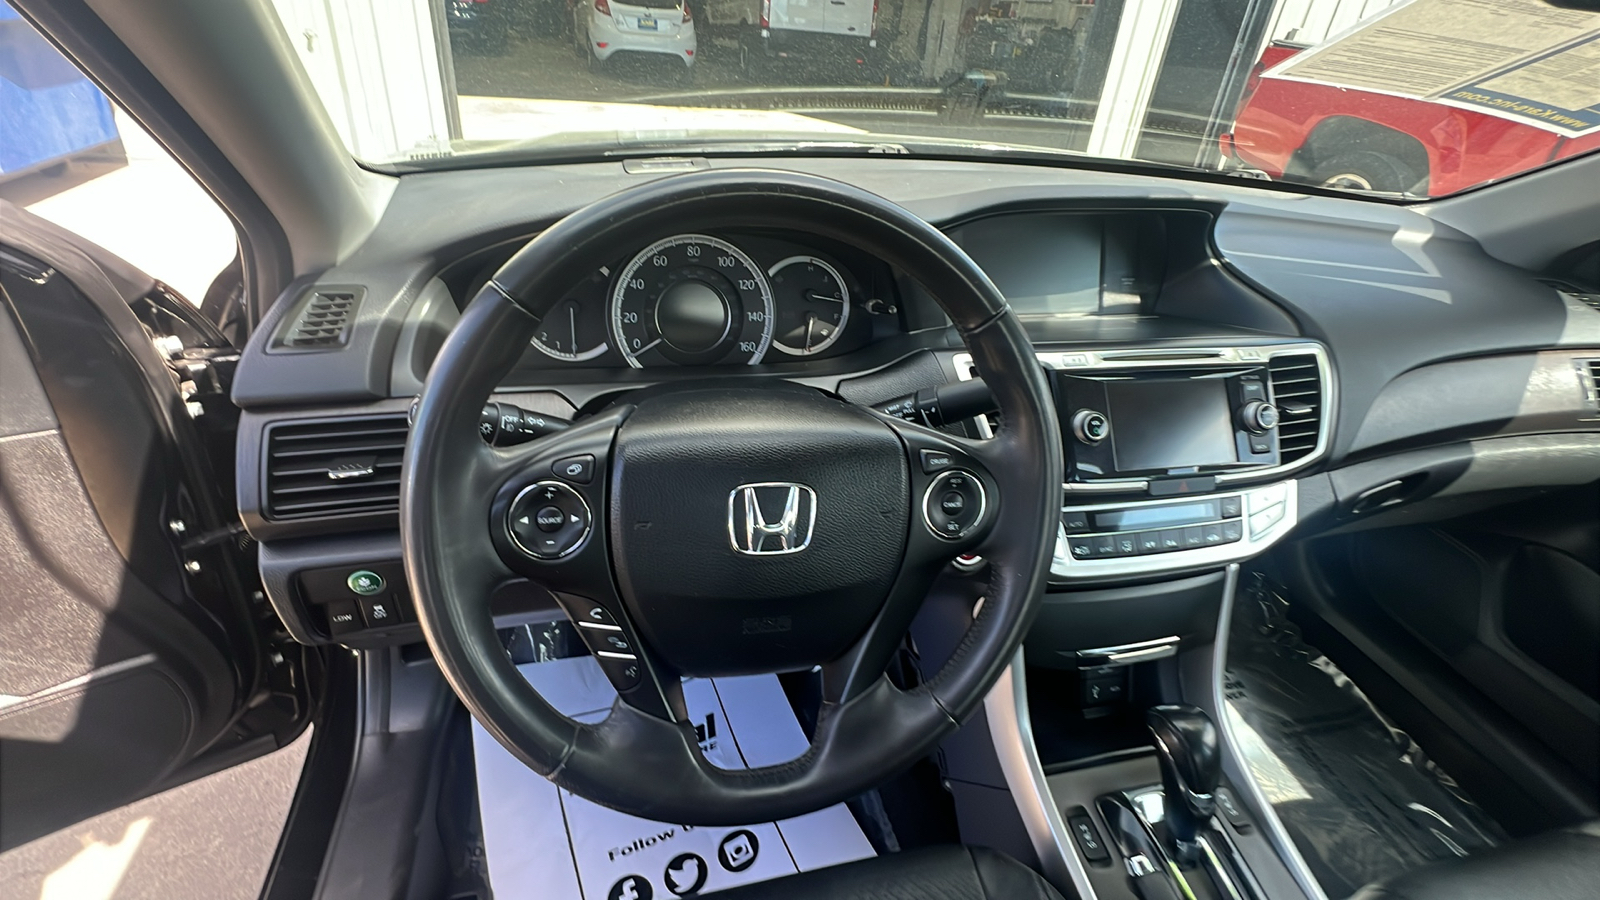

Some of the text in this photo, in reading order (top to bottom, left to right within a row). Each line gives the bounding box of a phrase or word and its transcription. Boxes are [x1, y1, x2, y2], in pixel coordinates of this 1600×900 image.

[686, 245, 701, 257] 80
[653, 255, 668, 267] 60
[717, 256, 735, 268] 100
[630, 278, 645, 290] 40
[738, 279, 755, 291] 120
[623, 312, 638, 323] 20
[747, 312, 764, 322] 140
[541, 331, 548, 341] 2
[555, 340, 561, 349] 1
[633, 339, 641, 349] 0
[739, 341, 756, 353] 160
[608, 829, 675, 862] Follow
